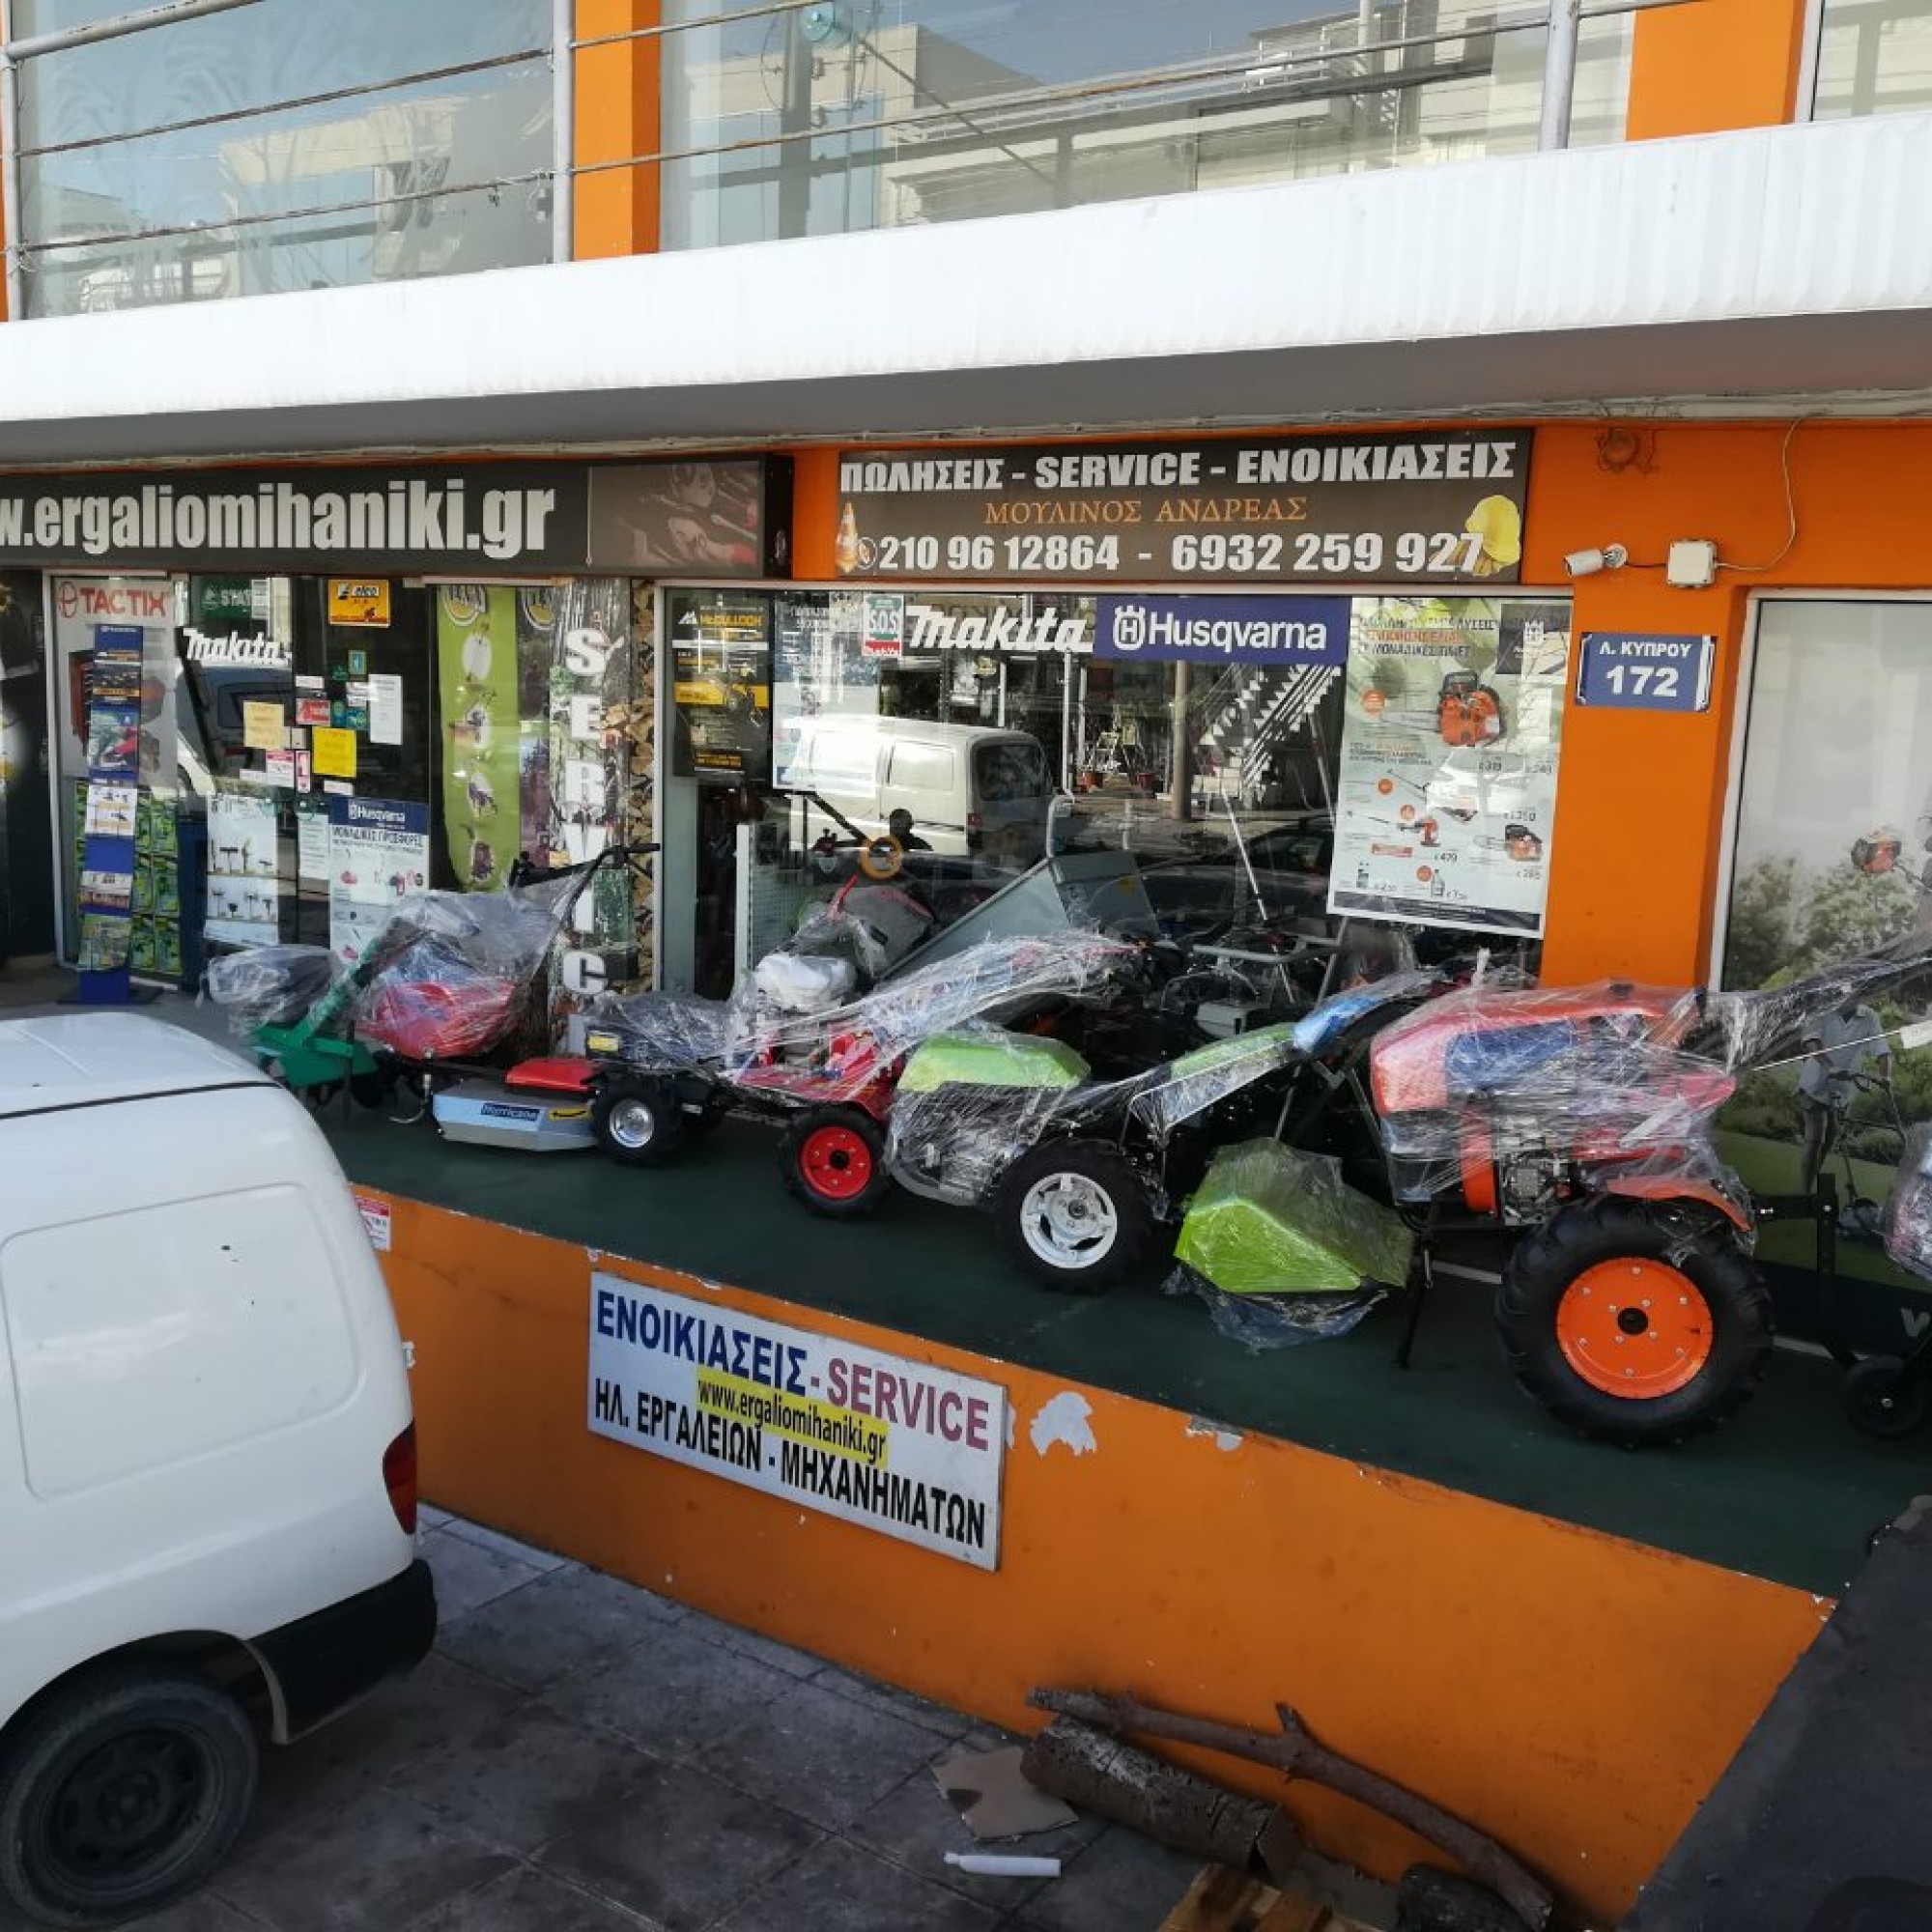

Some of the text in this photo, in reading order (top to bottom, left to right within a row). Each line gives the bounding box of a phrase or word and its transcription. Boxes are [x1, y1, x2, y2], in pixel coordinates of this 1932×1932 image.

[840, 459, 1005, 493] ΠΩΛΗΣΕΙΣ
[1035, 453, 1200, 489] SERVICE
[1236, 442, 1517, 484] ΕΝΟΙΚΙΑΣΕΙΣ
[983, 497, 1307, 526] ΜΟΥΛΙΝΟΣ ΑΝΔΡΕΑΣ
[879, 534, 939, 571] 210
[947, 534, 995, 571] 96
[1003, 534, 1120, 571] 12864
[1171, 532, 1283, 573] 6932
[1293, 532, 1383, 573] 259
[1396, 532, 1484, 573] 927
[80, 587, 166, 616] TACTIX
[906, 605, 1094, 653] makita
[1150, 611, 1327, 653] Husqvarna
[1621, 641, 1692, 658] ΚΥΠΡΟΥ
[1605, 664, 1679, 697] 172
[697, 1379, 887, 1465] www.ergaliomihaniki.gr
[595, 1378, 629, 1428] ΗΛ.
[637, 1391, 761, 1472] ΕΡΓΑΛΕΙΩΝ
[781, 1439, 986, 1549] ΜΗΧΑΝΗΜΑΤΩΝ
